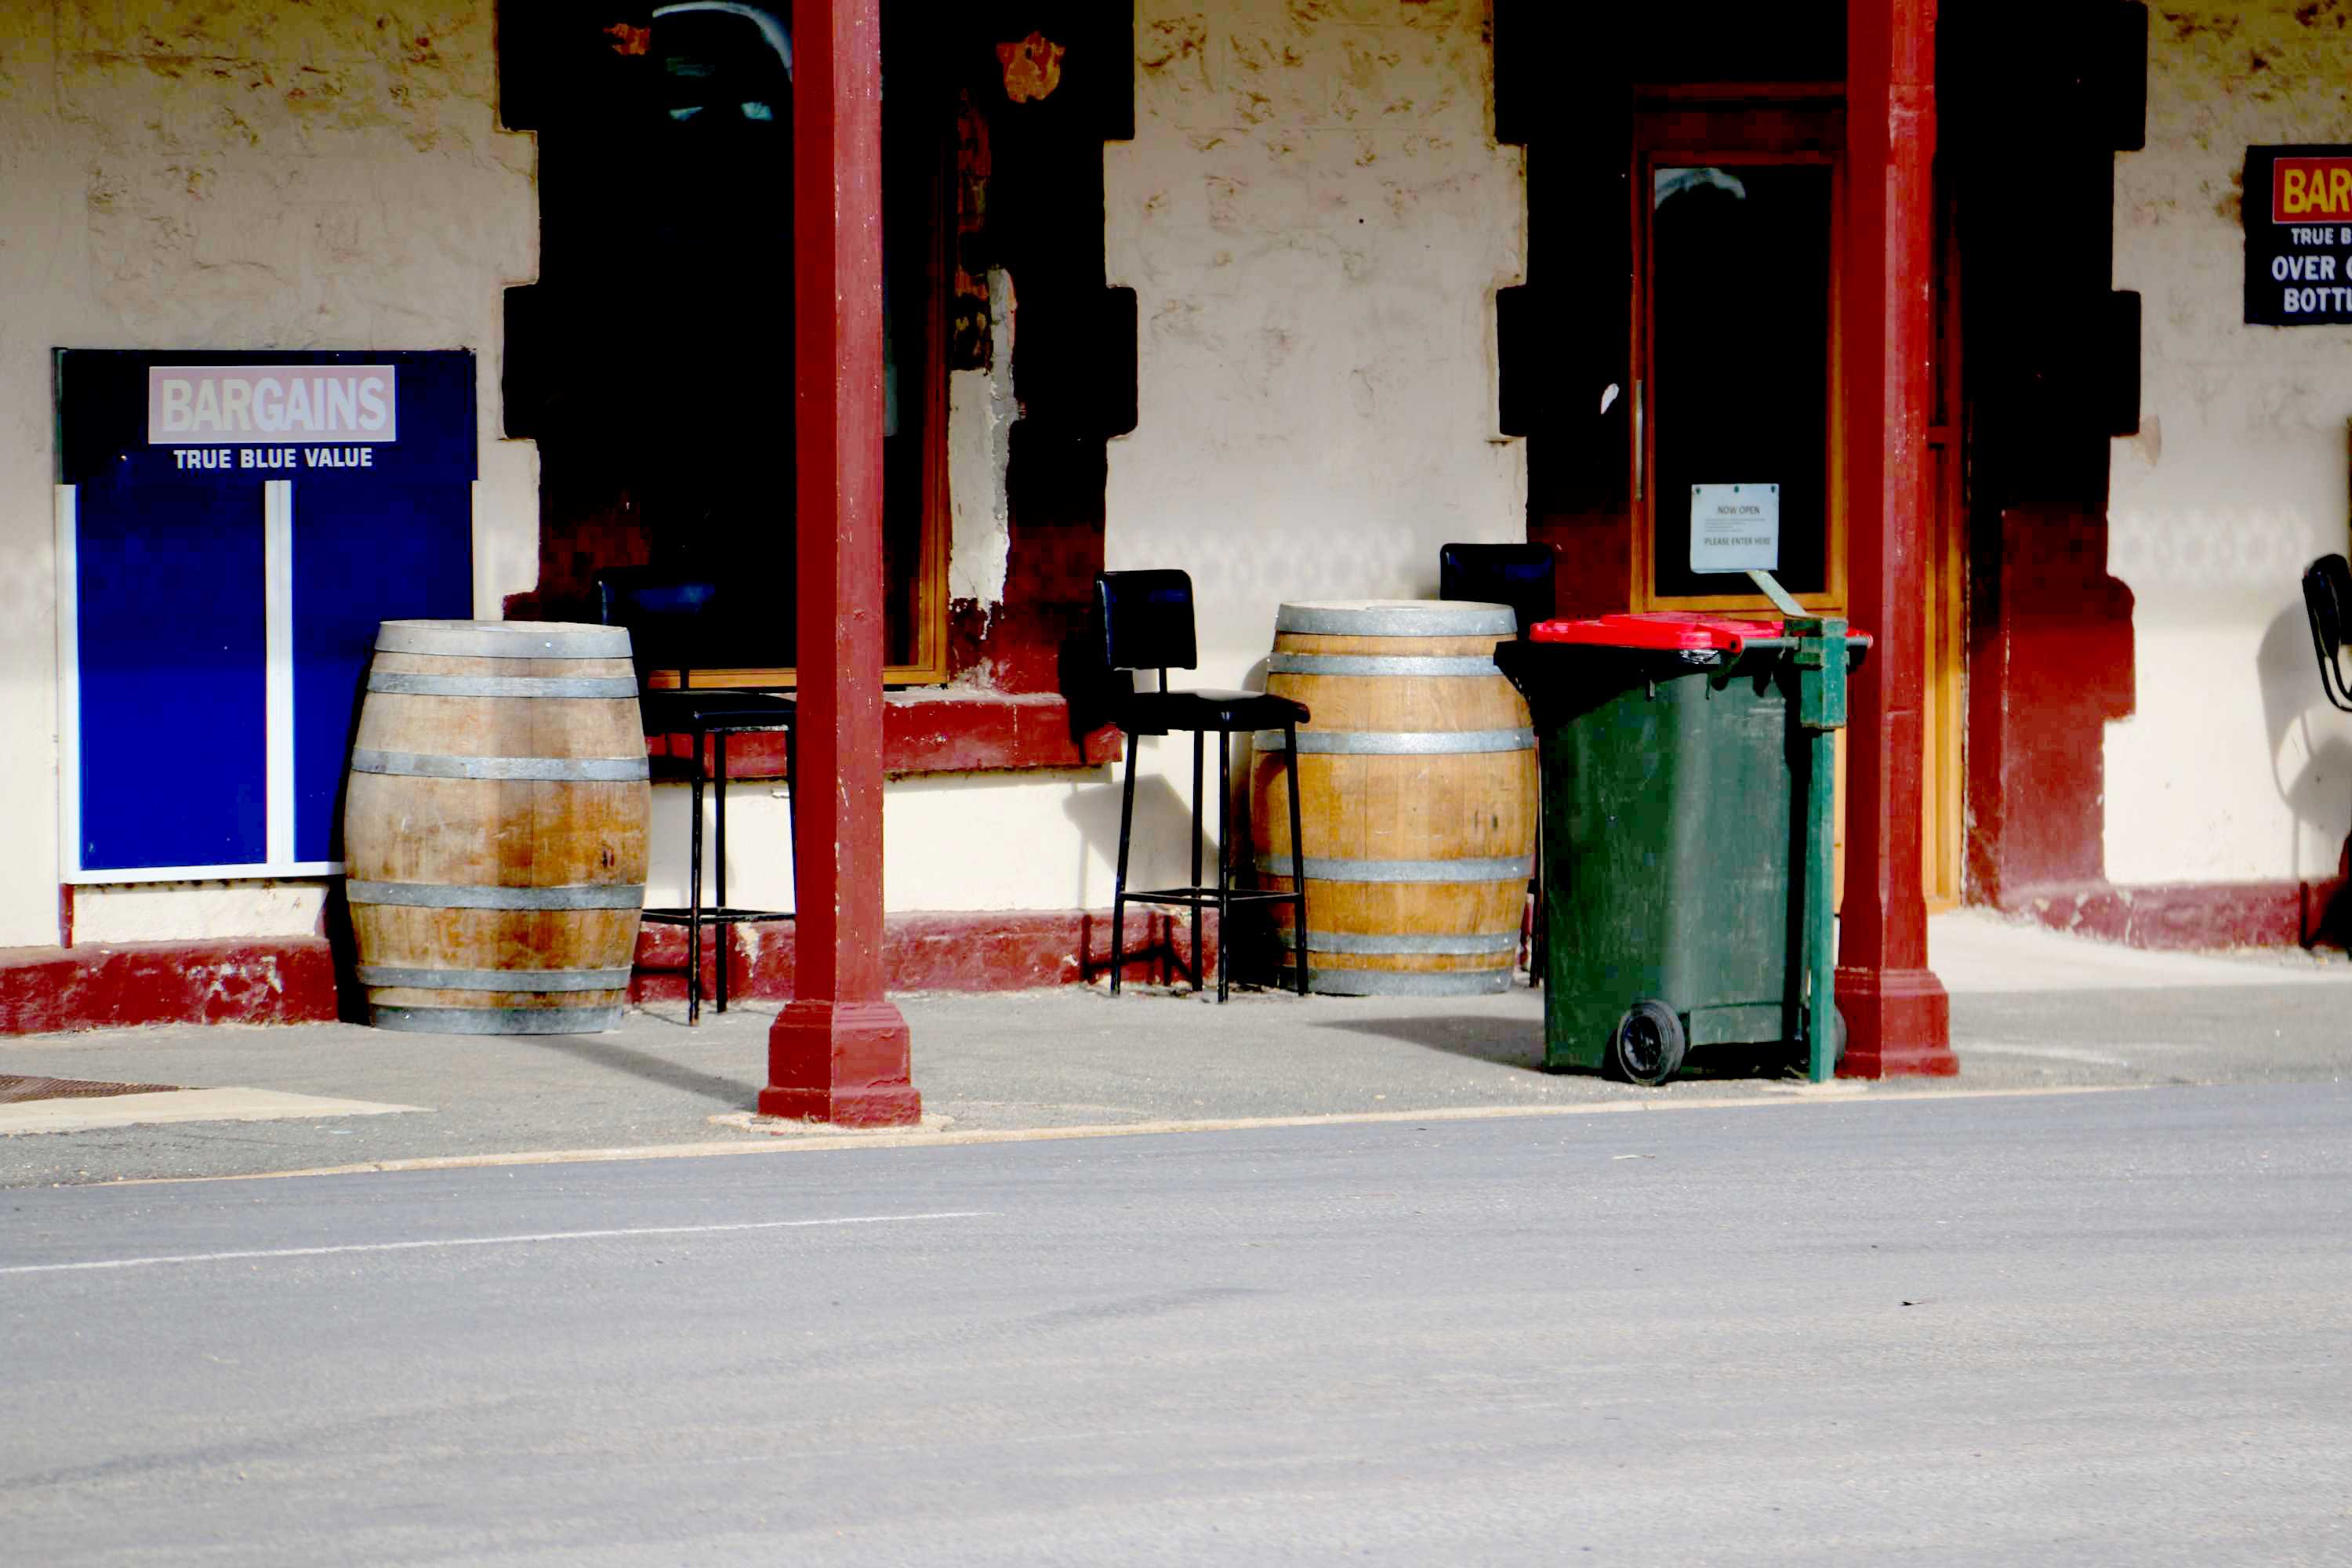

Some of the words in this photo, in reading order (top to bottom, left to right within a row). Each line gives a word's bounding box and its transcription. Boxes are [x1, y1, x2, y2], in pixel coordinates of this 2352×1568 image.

[2291, 227, 2334, 245] TRUE
[2271, 255, 2336, 281] OVER
[162, 376, 387, 431] BARGAINS
[173, 449, 232, 469] TRUE
[240, 448, 297, 468] BLUE
[304, 447, 373, 467] VALUE
[1739, 506, 1761, 514] OPEN
